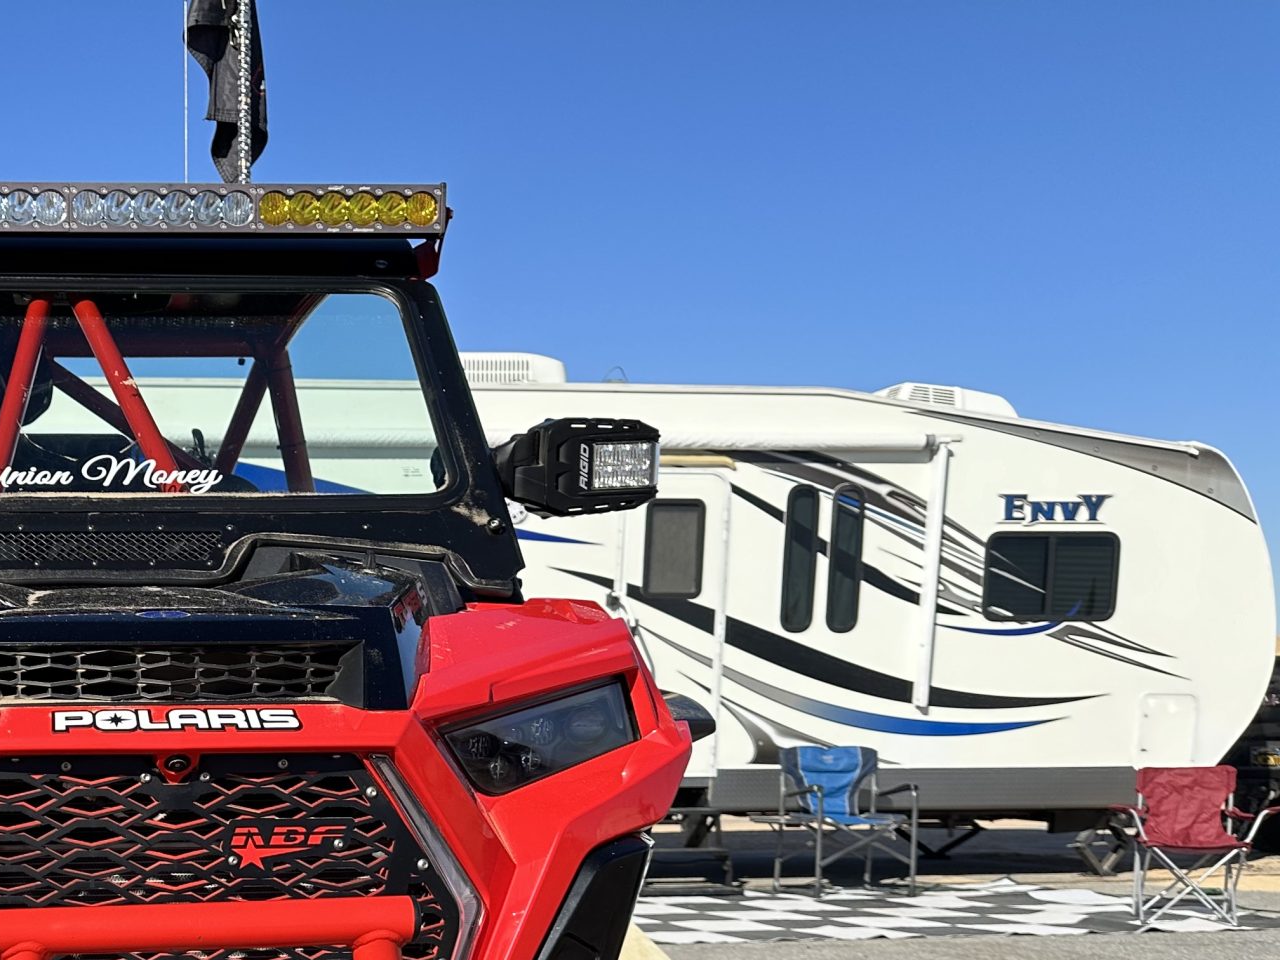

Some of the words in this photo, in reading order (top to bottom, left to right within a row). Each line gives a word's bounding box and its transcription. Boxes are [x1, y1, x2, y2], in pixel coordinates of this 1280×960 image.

[81, 454, 224, 494] Money
[578, 443, 590, 490] RIGID
[53, 708, 303, 733] POLARIS
